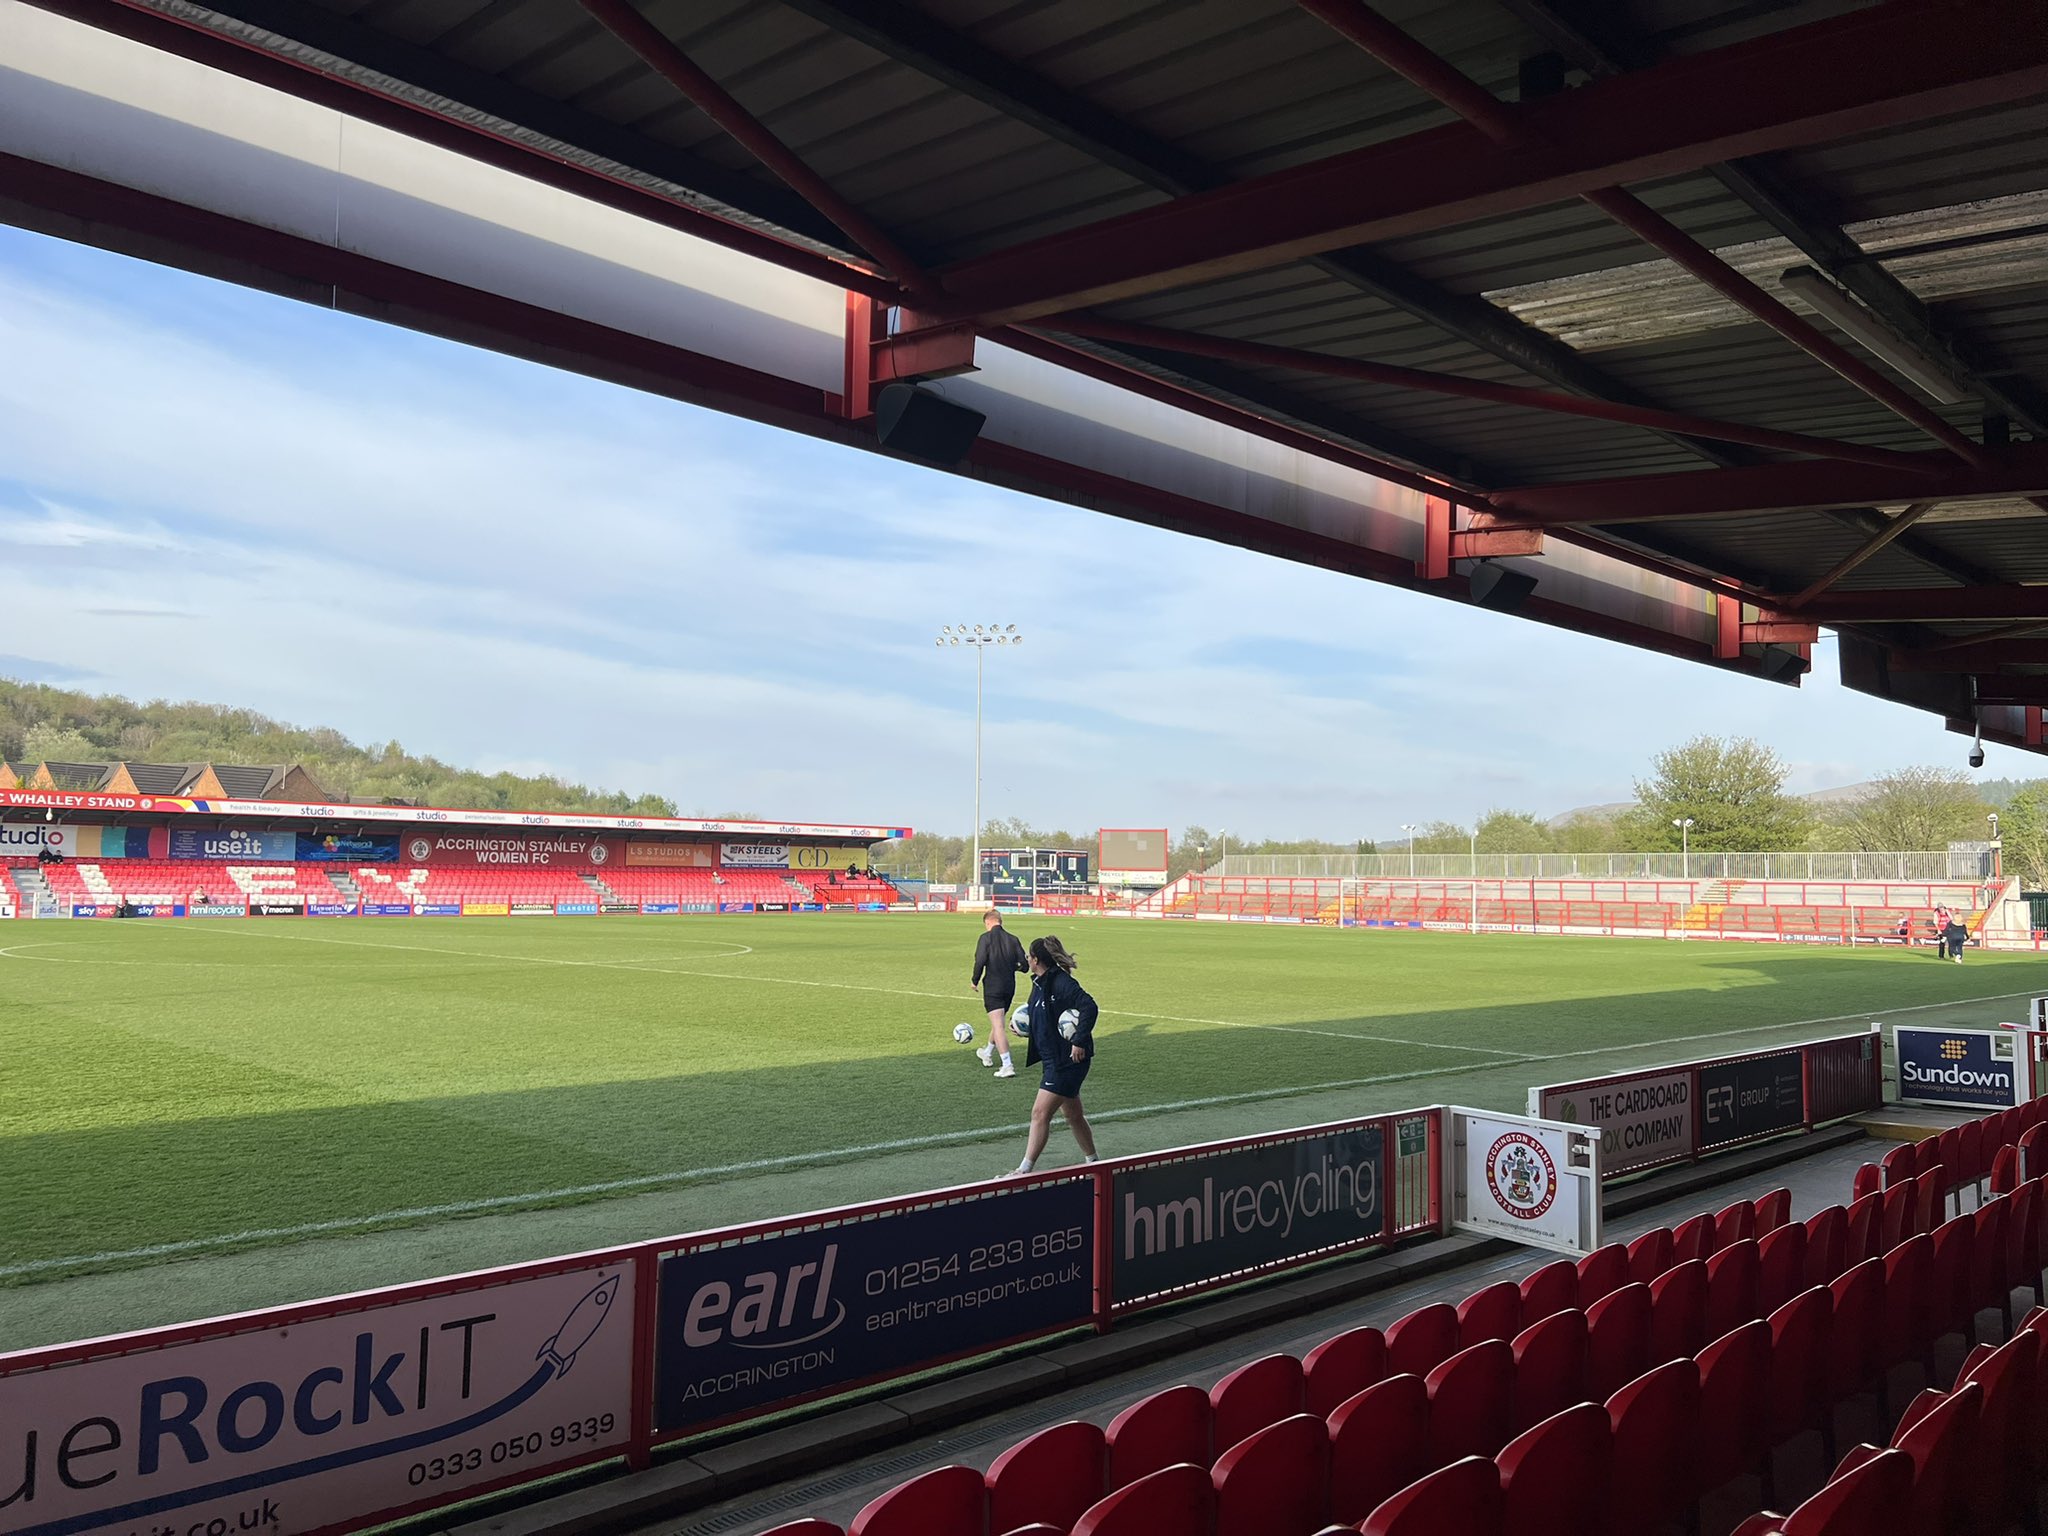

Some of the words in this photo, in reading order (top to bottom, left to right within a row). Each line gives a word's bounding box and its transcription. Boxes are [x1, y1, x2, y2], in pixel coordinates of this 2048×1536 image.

[9, 793, 84, 806] WHALLEY
[87, 797, 136, 808] STAND
[300, 805, 335, 816] studio
[416, 811, 447, 820] studio
[521, 815, 550, 825] studio
[617, 819, 643, 827] studio
[779, 825, 801, 834] studio
[850, 828, 871, 836] studio
[435, 838, 528, 851] ACCRINGTON
[529, 841, 587, 853] STANLEY
[647, 848, 691, 856] STUDIOS
[746, 846, 782, 854] STEELS
[476, 851, 529, 863] WOMEN
[532, 852, 550, 864] FC
[78, 906, 95, 916] sky
[97, 906, 116, 915] bet
[138, 906, 154, 916] sky
[155, 905, 172, 914] bet
[268, 906, 294, 914] macron
[922, 902, 942, 910] studio
[1903, 1061, 2010, 1088] Sundown
[1904, 1083, 1945, 1092] Technology
[1961, 1087, 1983, 1095] works
[1590, 1094, 1611, 1121] THE
[1615, 1082, 1688, 1116] CARDBOARD
[1740, 1087, 1770, 1107] GROUP
[1602, 1127, 1621, 1154] OX
[1624, 1115, 1684, 1149] COMPANY
[1487, 1134, 1528, 1167] ACCRINGTON
[1529, 1140, 1555, 1179] STANLEY
[1489, 1182, 1530, 1218] FOOTBALL
[1533, 1194, 1553, 1216] CLUB
[865, 1253, 960, 1296] 01254
[969, 1239, 1023, 1273] 233
[1031, 1226, 1083, 1258] 865
[683, 1243, 838, 1348] earl
[865, 1262, 1082, 1332] earltransport.co.uk
[682, 1347, 835, 1403] ACCRINGTON
[407, 1448, 482, 1486] 0333
[490, 1432, 543, 1464] 050
[550, 1413, 616, 1448] 9339
